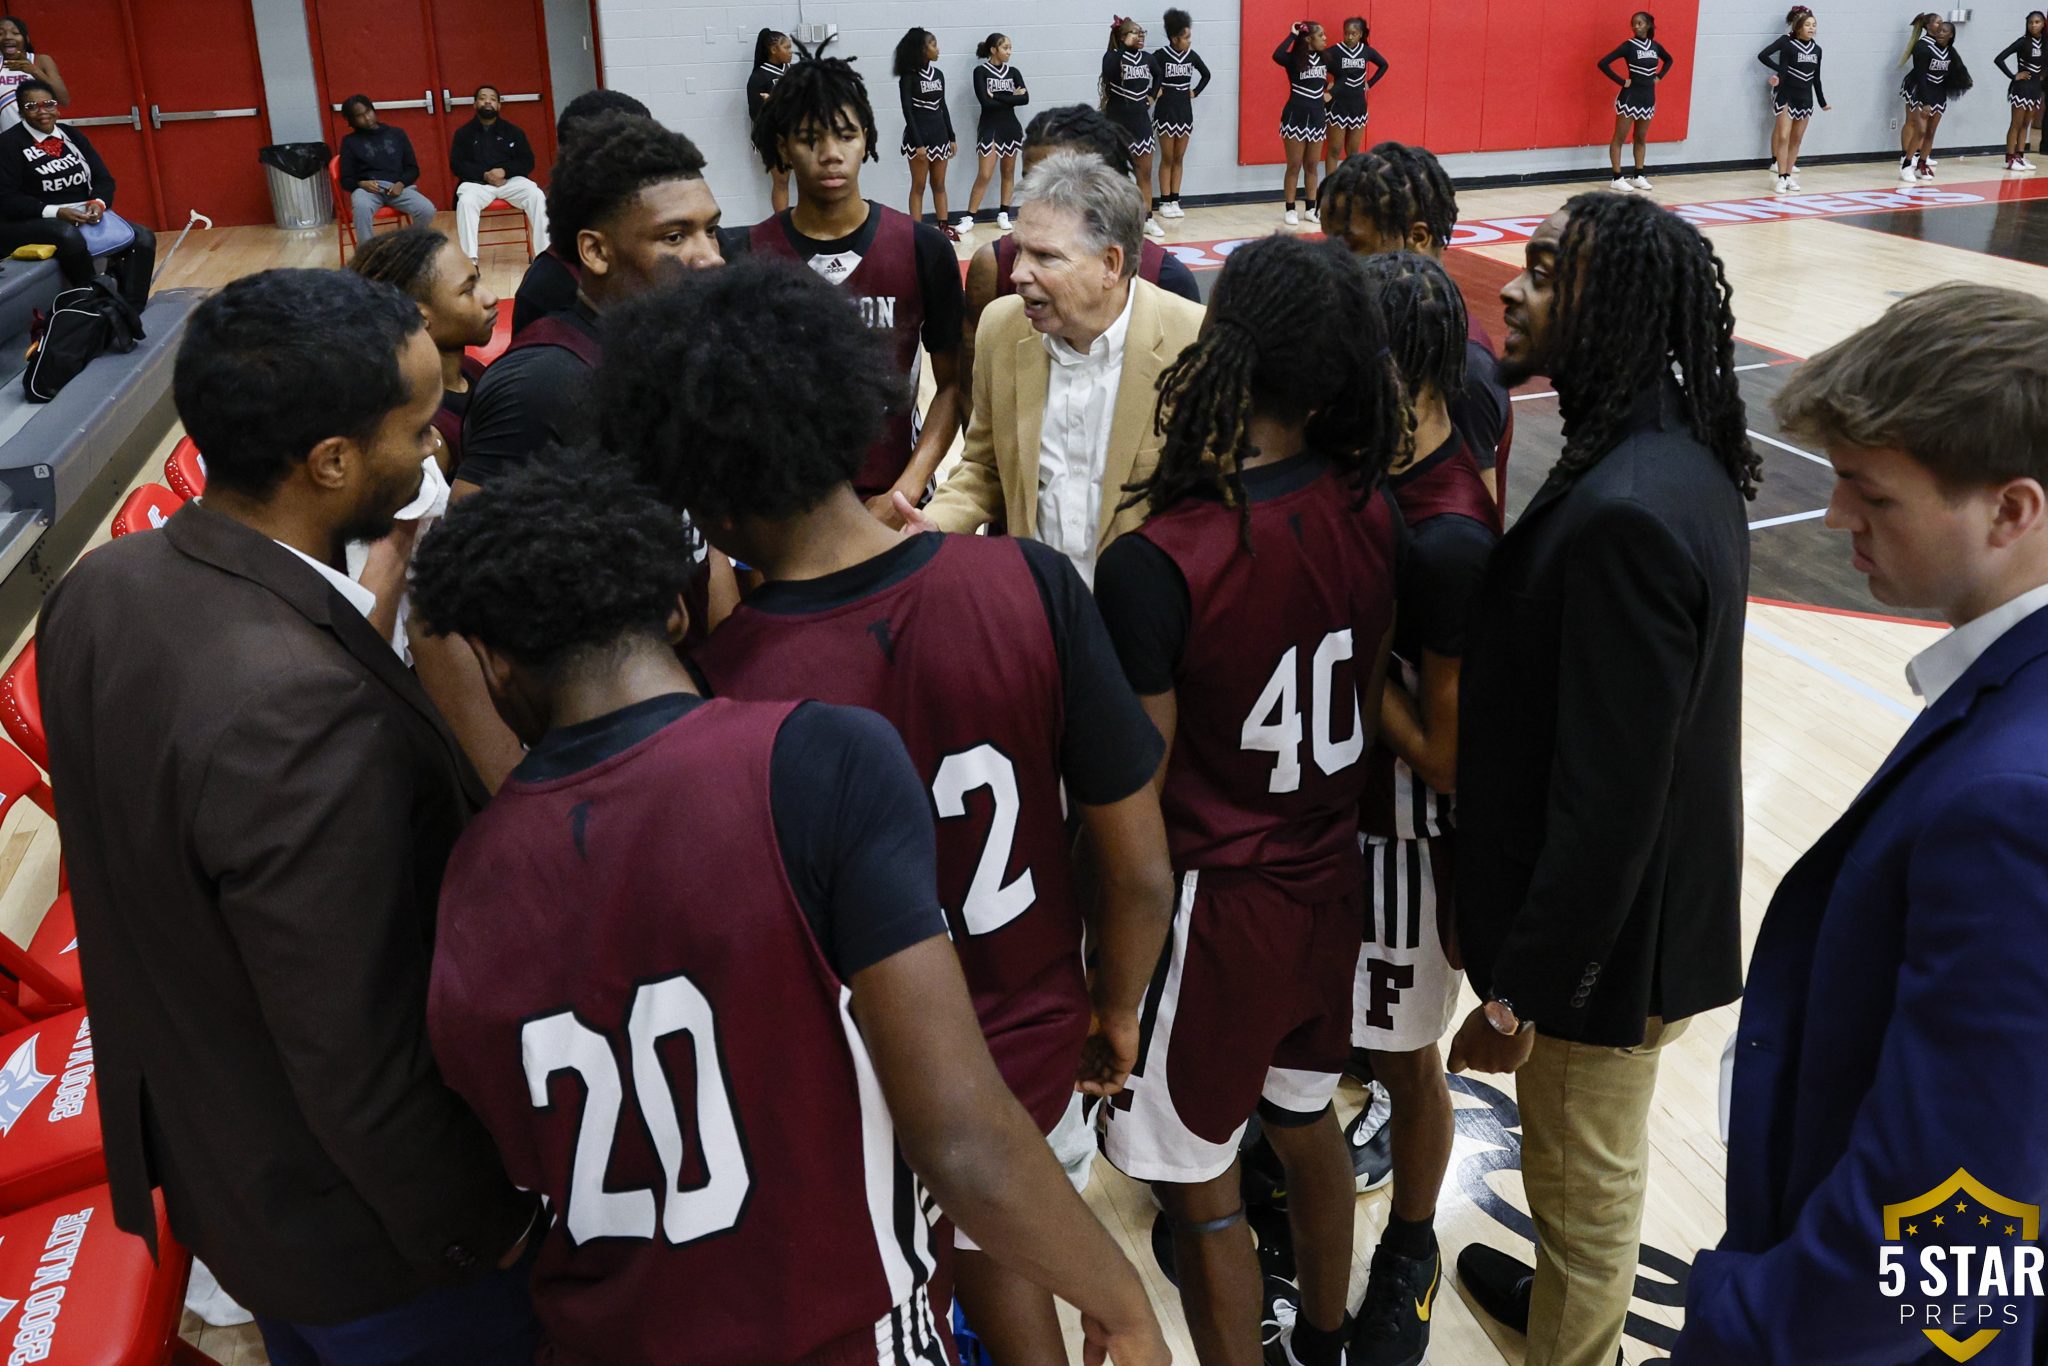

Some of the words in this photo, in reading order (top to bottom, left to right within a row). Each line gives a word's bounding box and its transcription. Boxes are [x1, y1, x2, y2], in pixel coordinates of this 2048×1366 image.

[22, 145, 47, 162] RE
[824, 266, 848, 274] adidas
[37, 469, 47, 478] A
[1239, 627, 1365, 794] 40
[930, 742, 1038, 942] 2
[1365, 957, 1415, 1032] F
[47, 1063, 95, 1123] 2800
[520, 974, 751, 1247] 20
[29, 1206, 95, 1291] MADE
[7, 1285, 67, 1366] 2800
